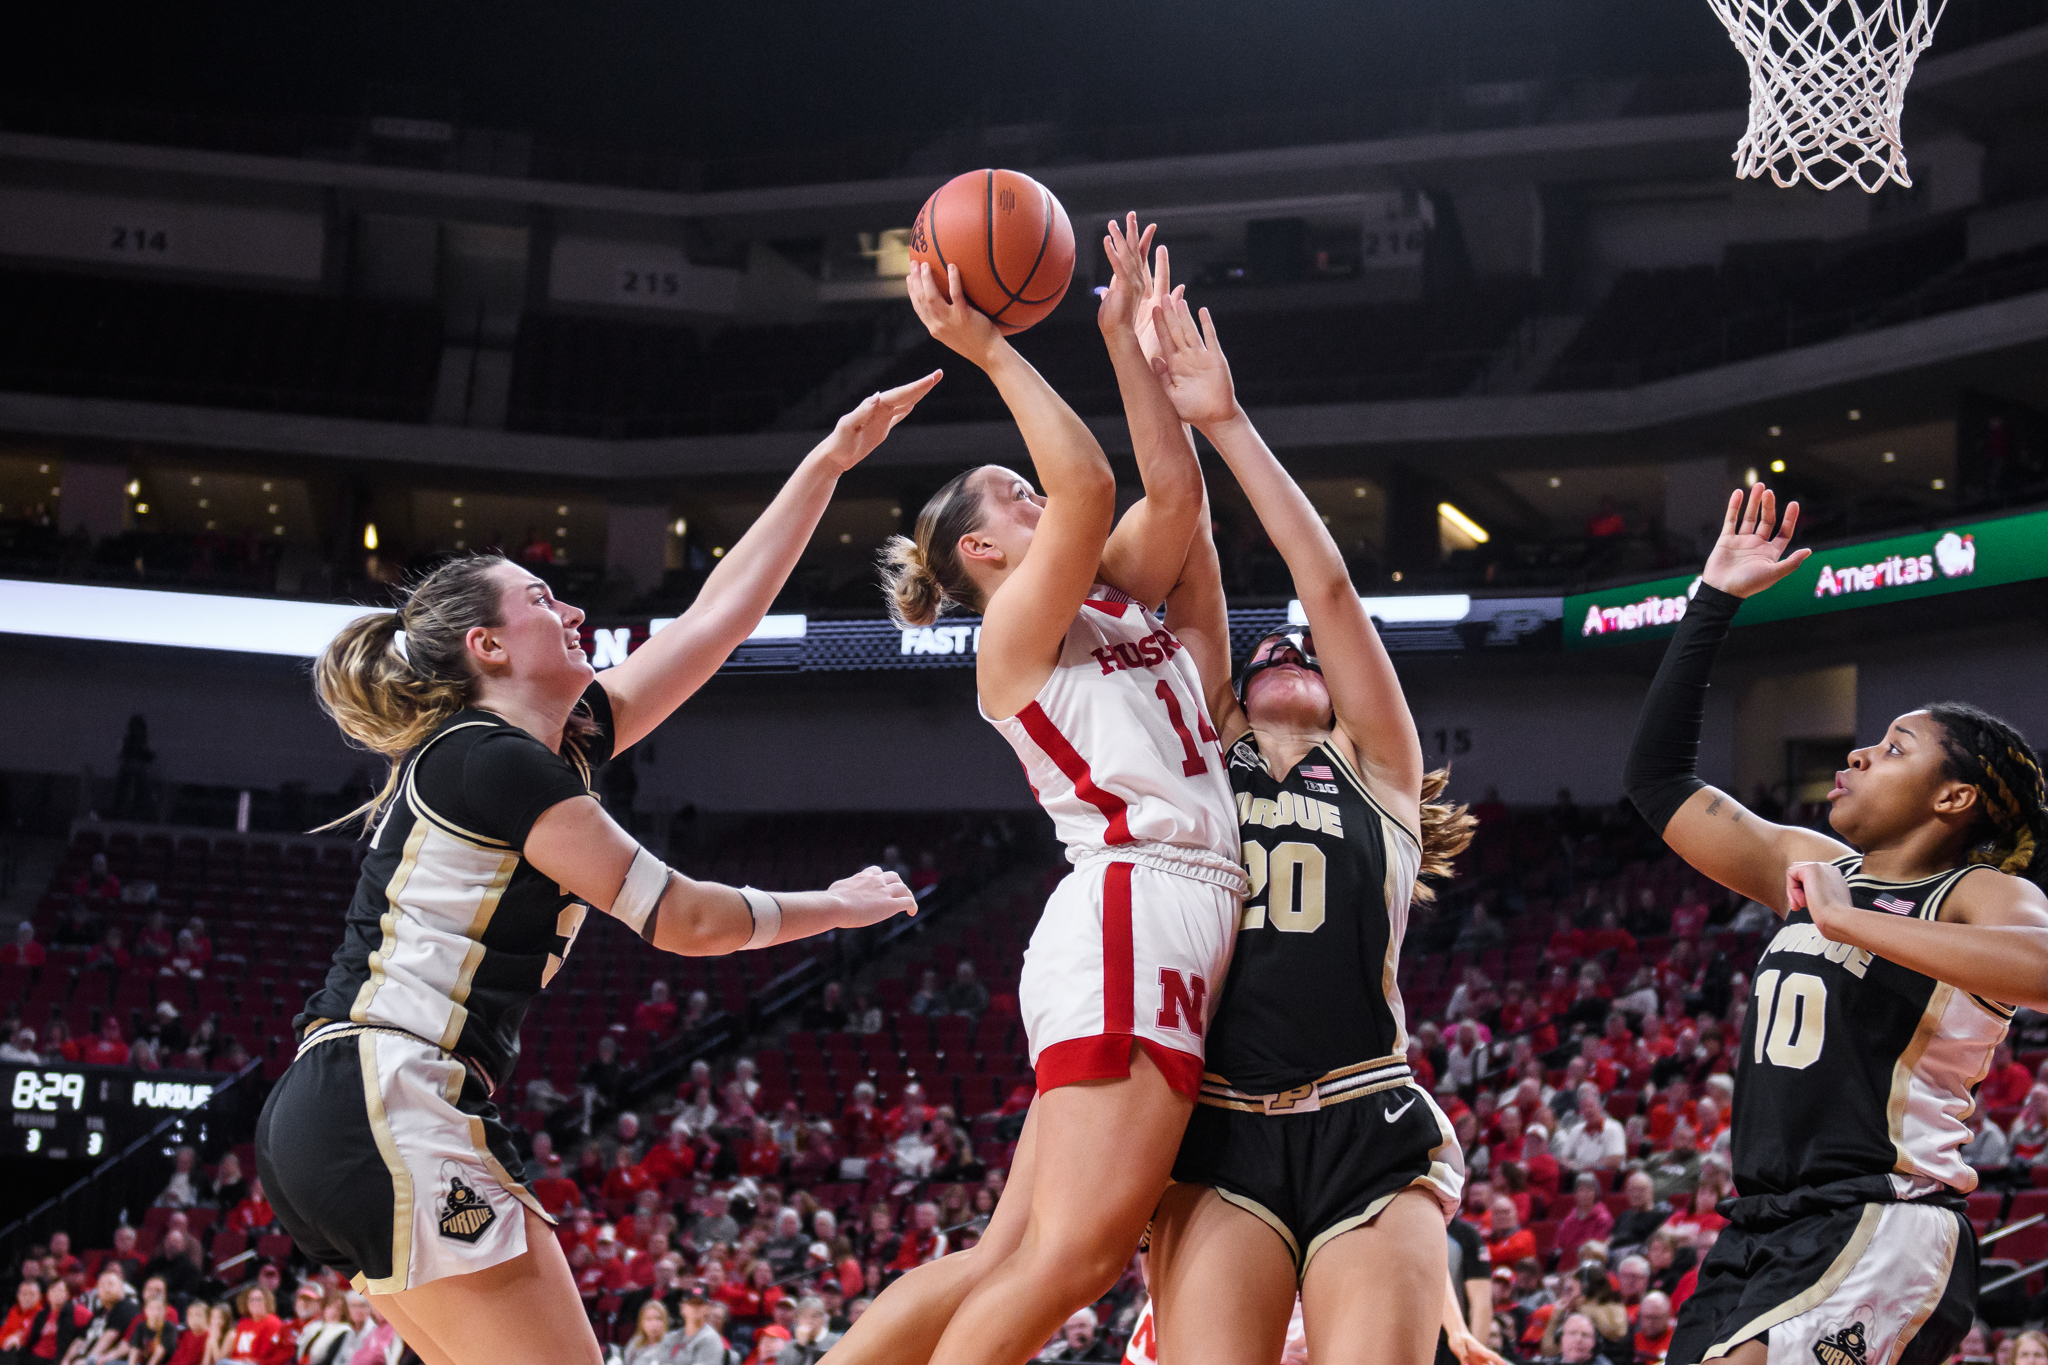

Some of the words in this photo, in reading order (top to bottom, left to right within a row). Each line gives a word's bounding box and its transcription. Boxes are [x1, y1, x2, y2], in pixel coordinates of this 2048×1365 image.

[110, 226, 167, 252] 214
[623, 269, 679, 295] 215
[1815, 554, 1935, 598] Ameritas
[1582, 594, 1688, 636] Ameritas
[592, 627, 631, 668] N
[901, 626, 972, 655] FAST
[1419, 728, 1471, 754] 15
[1236, 791, 1344, 839] URDUE
[1238, 840, 1326, 933] 20
[1755, 969, 1827, 1070] 10
[12, 1071, 85, 1111] 8:29
[442, 1207, 493, 1235] PURDUE
